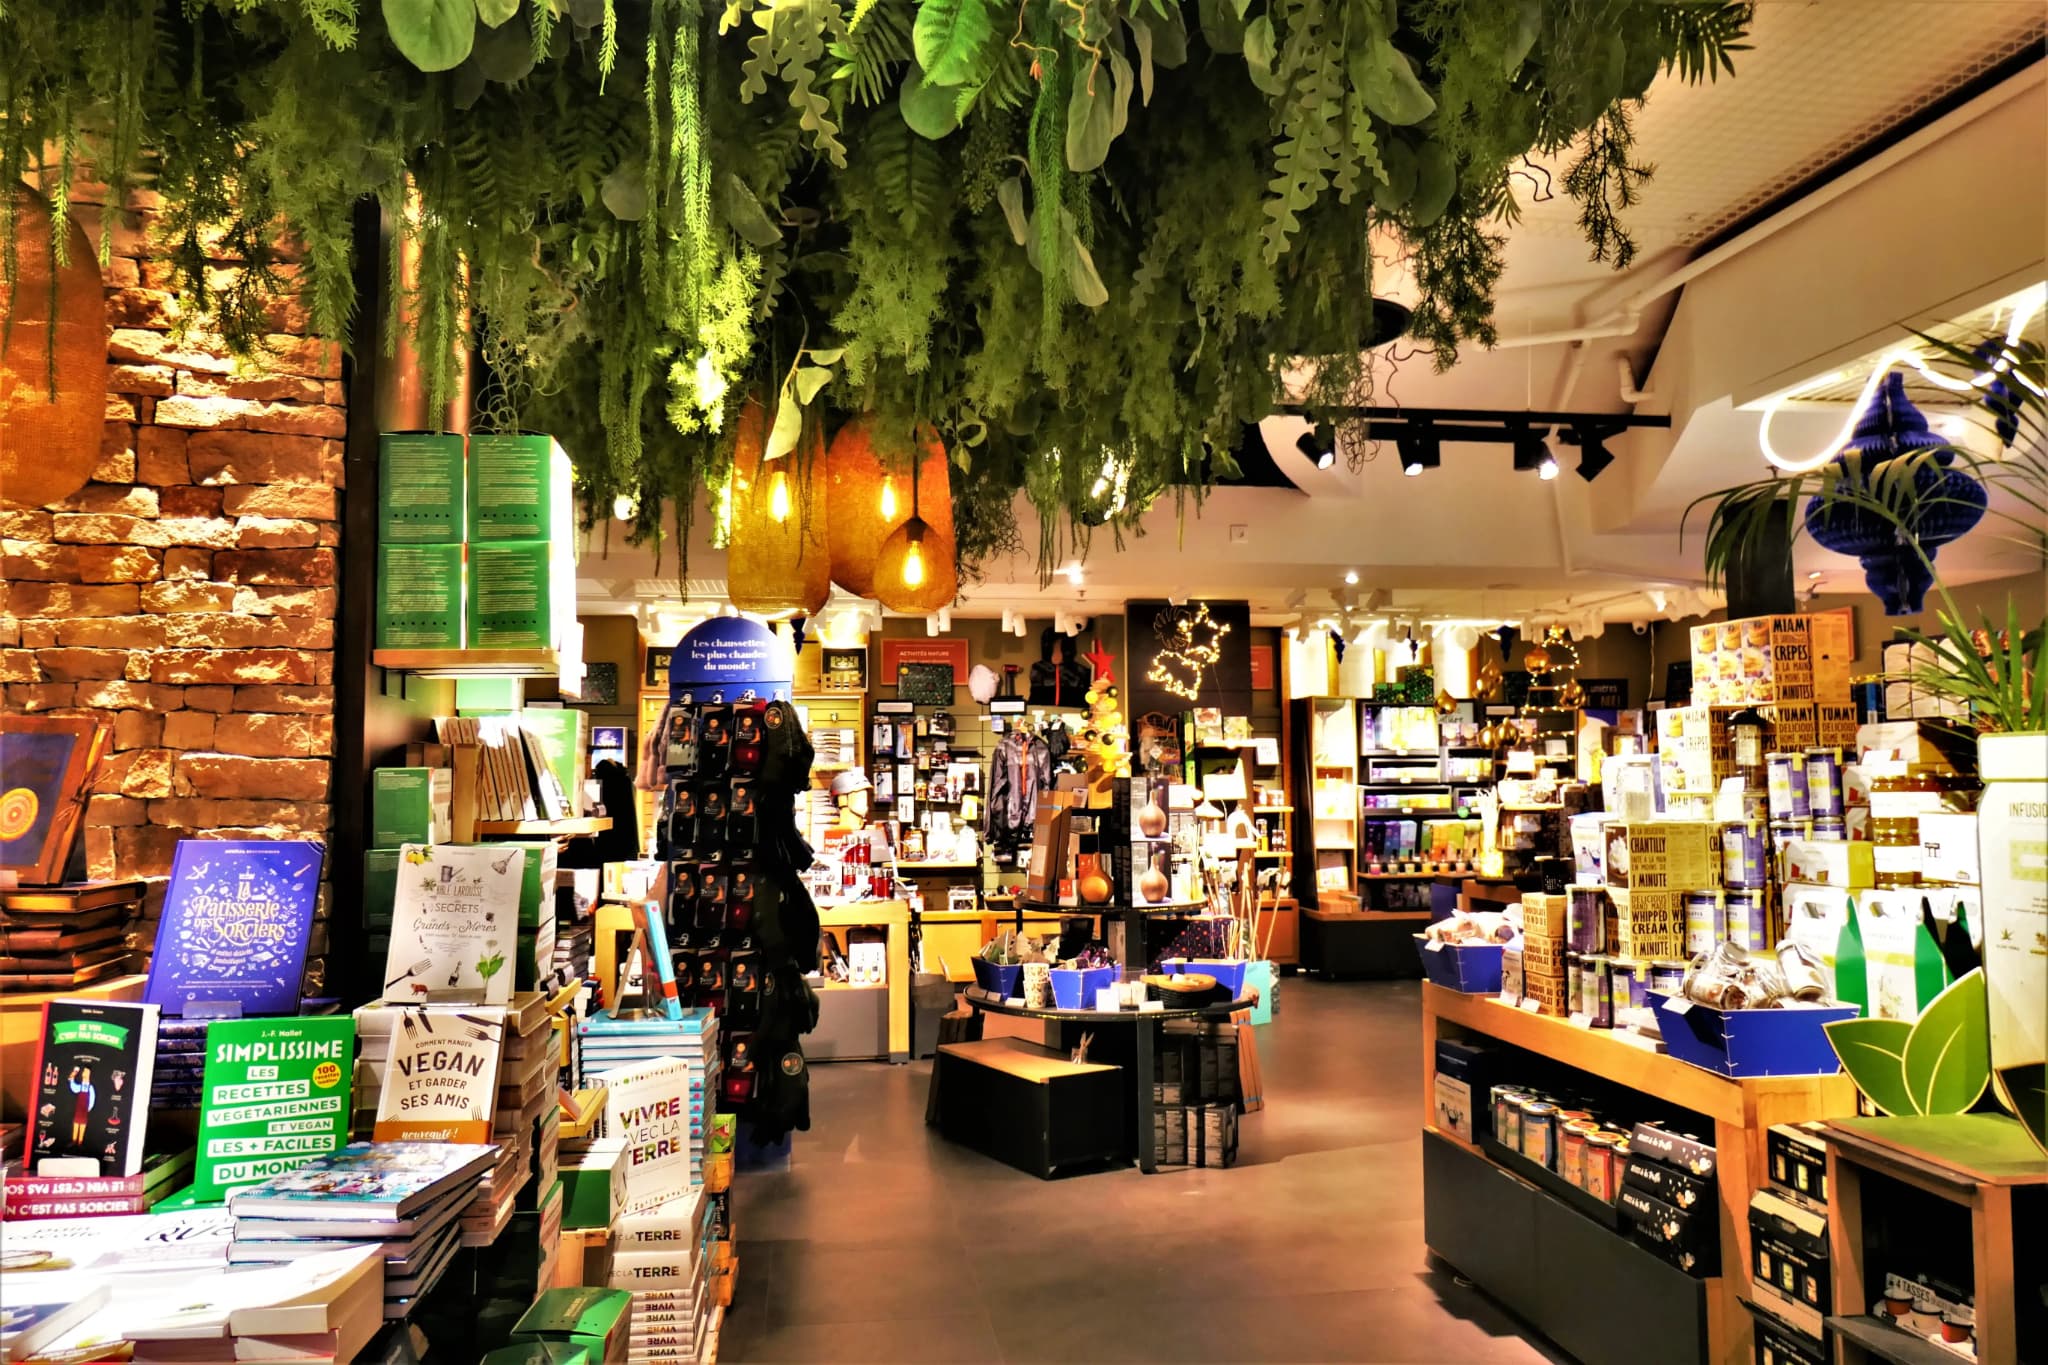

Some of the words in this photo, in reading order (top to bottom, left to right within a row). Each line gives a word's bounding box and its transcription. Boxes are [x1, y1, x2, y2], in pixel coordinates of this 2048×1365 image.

[693, 639, 709, 647] Les
[691, 650, 705, 659] les
[707, 650, 727, 661] plus
[729, 650, 768, 659] chaudes
[704, 662, 716, 670] du
[718, 662, 751, 670] monde
[1710, 709, 1729, 723] YUM
[1778, 707, 1813, 721] YUMMY
[1822, 707, 1856, 721] YUMMY
[1630, 837, 1666, 853] CHANTILLY
[1638, 873, 1667, 888] MINUTE
[435, 902, 479, 914] SECRETS
[1631, 910, 1668, 922] WHIPPED
[1631, 922, 1669, 935] CREAM
[1639, 941, 1669, 957] MINUTE
[415, 1039, 445, 1049] COMMENT
[447, 1039, 473, 1048] MANGER
[215, 1040, 343, 1063] SIMPLISSIME
[317, 1065, 337, 1074] 100
[398, 1050, 485, 1077] VEGAN
[250, 1067, 275, 1078] LES
[408, 1080, 422, 1091] ET
[425, 1078, 468, 1090] GARDER
[217, 1083, 306, 1101] RECETTES
[400, 1094, 429, 1111] SES
[433, 1093, 470, 1110] AMIS
[619, 1097, 681, 1130] VIVRE
[271, 1123, 285, 1132] ET
[289, 1119, 331, 1131] VEGAN
[662, 1119, 680, 1136] LA
[213, 1142, 244, 1154] LES
[264, 1137, 332, 1151] FACILES
[627, 1137, 681, 1166] ERRE
[219, 1165, 246, 1180] DU
[28, 1183, 49, 1194] PAS
[87, 1182, 110, 1192] VIN
[112, 1181, 124, 1192] LE
[19, 1203, 52, 1215] C'EST
[54, 1202, 77, 1214] PAS
[79, 1201, 129, 1214] SORCIER
[635, 1229, 682, 1242] TERRE
[633, 1266, 680, 1278] TERRE
[1903, 1281, 1930, 1303] TASSES
[645, 1303, 675, 1311] VIVRE
[646, 1314, 676, 1322] VIVRE
[647, 1337, 677, 1346] VIVRE
[647, 1348, 677, 1357] VIVRE
